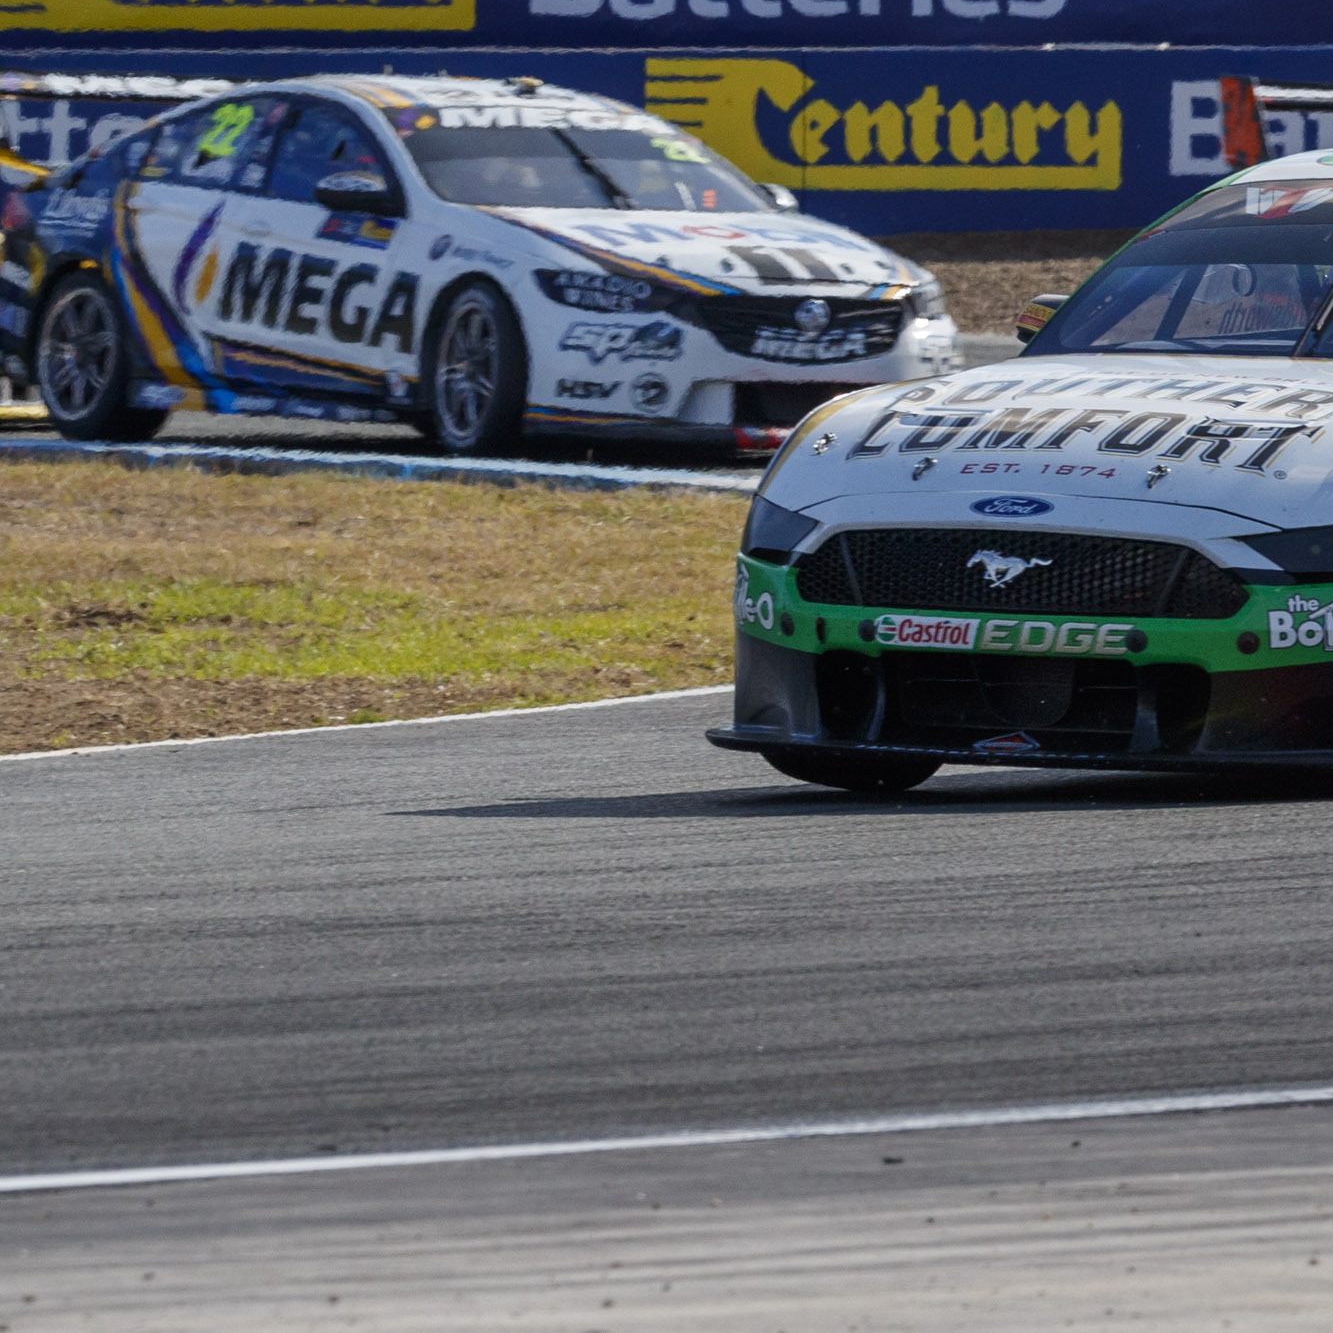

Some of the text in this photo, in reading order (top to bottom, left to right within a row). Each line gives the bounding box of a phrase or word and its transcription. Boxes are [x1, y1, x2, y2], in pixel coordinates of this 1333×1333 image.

[196, 102, 255, 158] 22
[646, 58, 1122, 191] Century
[218, 239, 422, 355] MEGA
[556, 378, 622, 399] HSV
[845, 406, 1326, 474] COMFORT
[959, 462, 1116, 480] EST. 1874
[982, 496, 1034, 517] Ford
[1287, 593, 1321, 613] the
[896, 618, 1136, 656] Castrol EDGE
